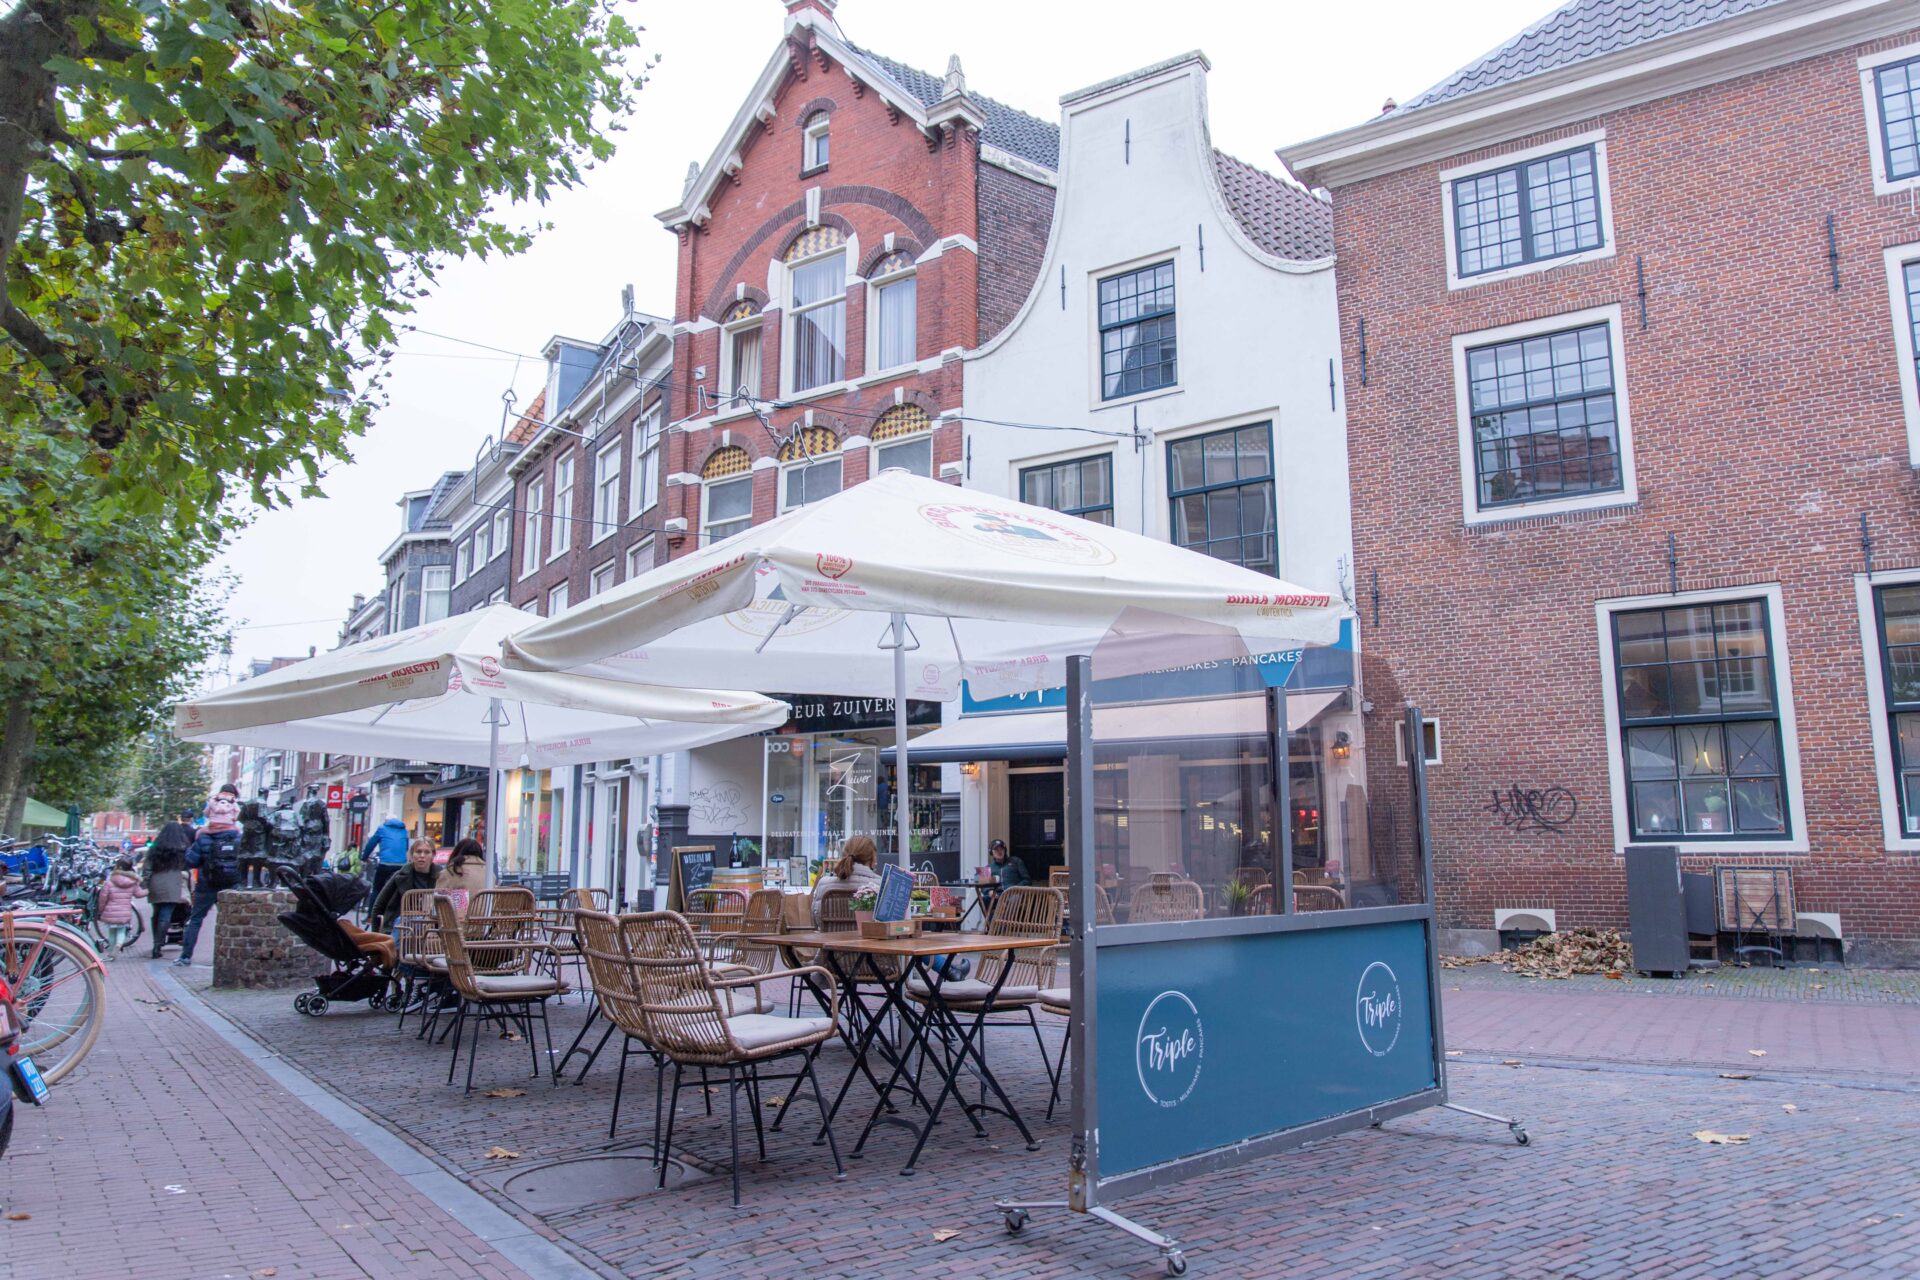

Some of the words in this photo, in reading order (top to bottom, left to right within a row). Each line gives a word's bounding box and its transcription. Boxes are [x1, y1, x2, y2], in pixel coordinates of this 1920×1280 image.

[1273, 594, 1330, 608] MORETTI
[1232, 651, 1304, 667] PANCAKES
[391, 660, 440, 678] MORETTI
[833, 698, 896, 716] ZUIVER
[1360, 991, 1396, 1028] Triple
[1141, 1026, 1196, 1072] Triple
